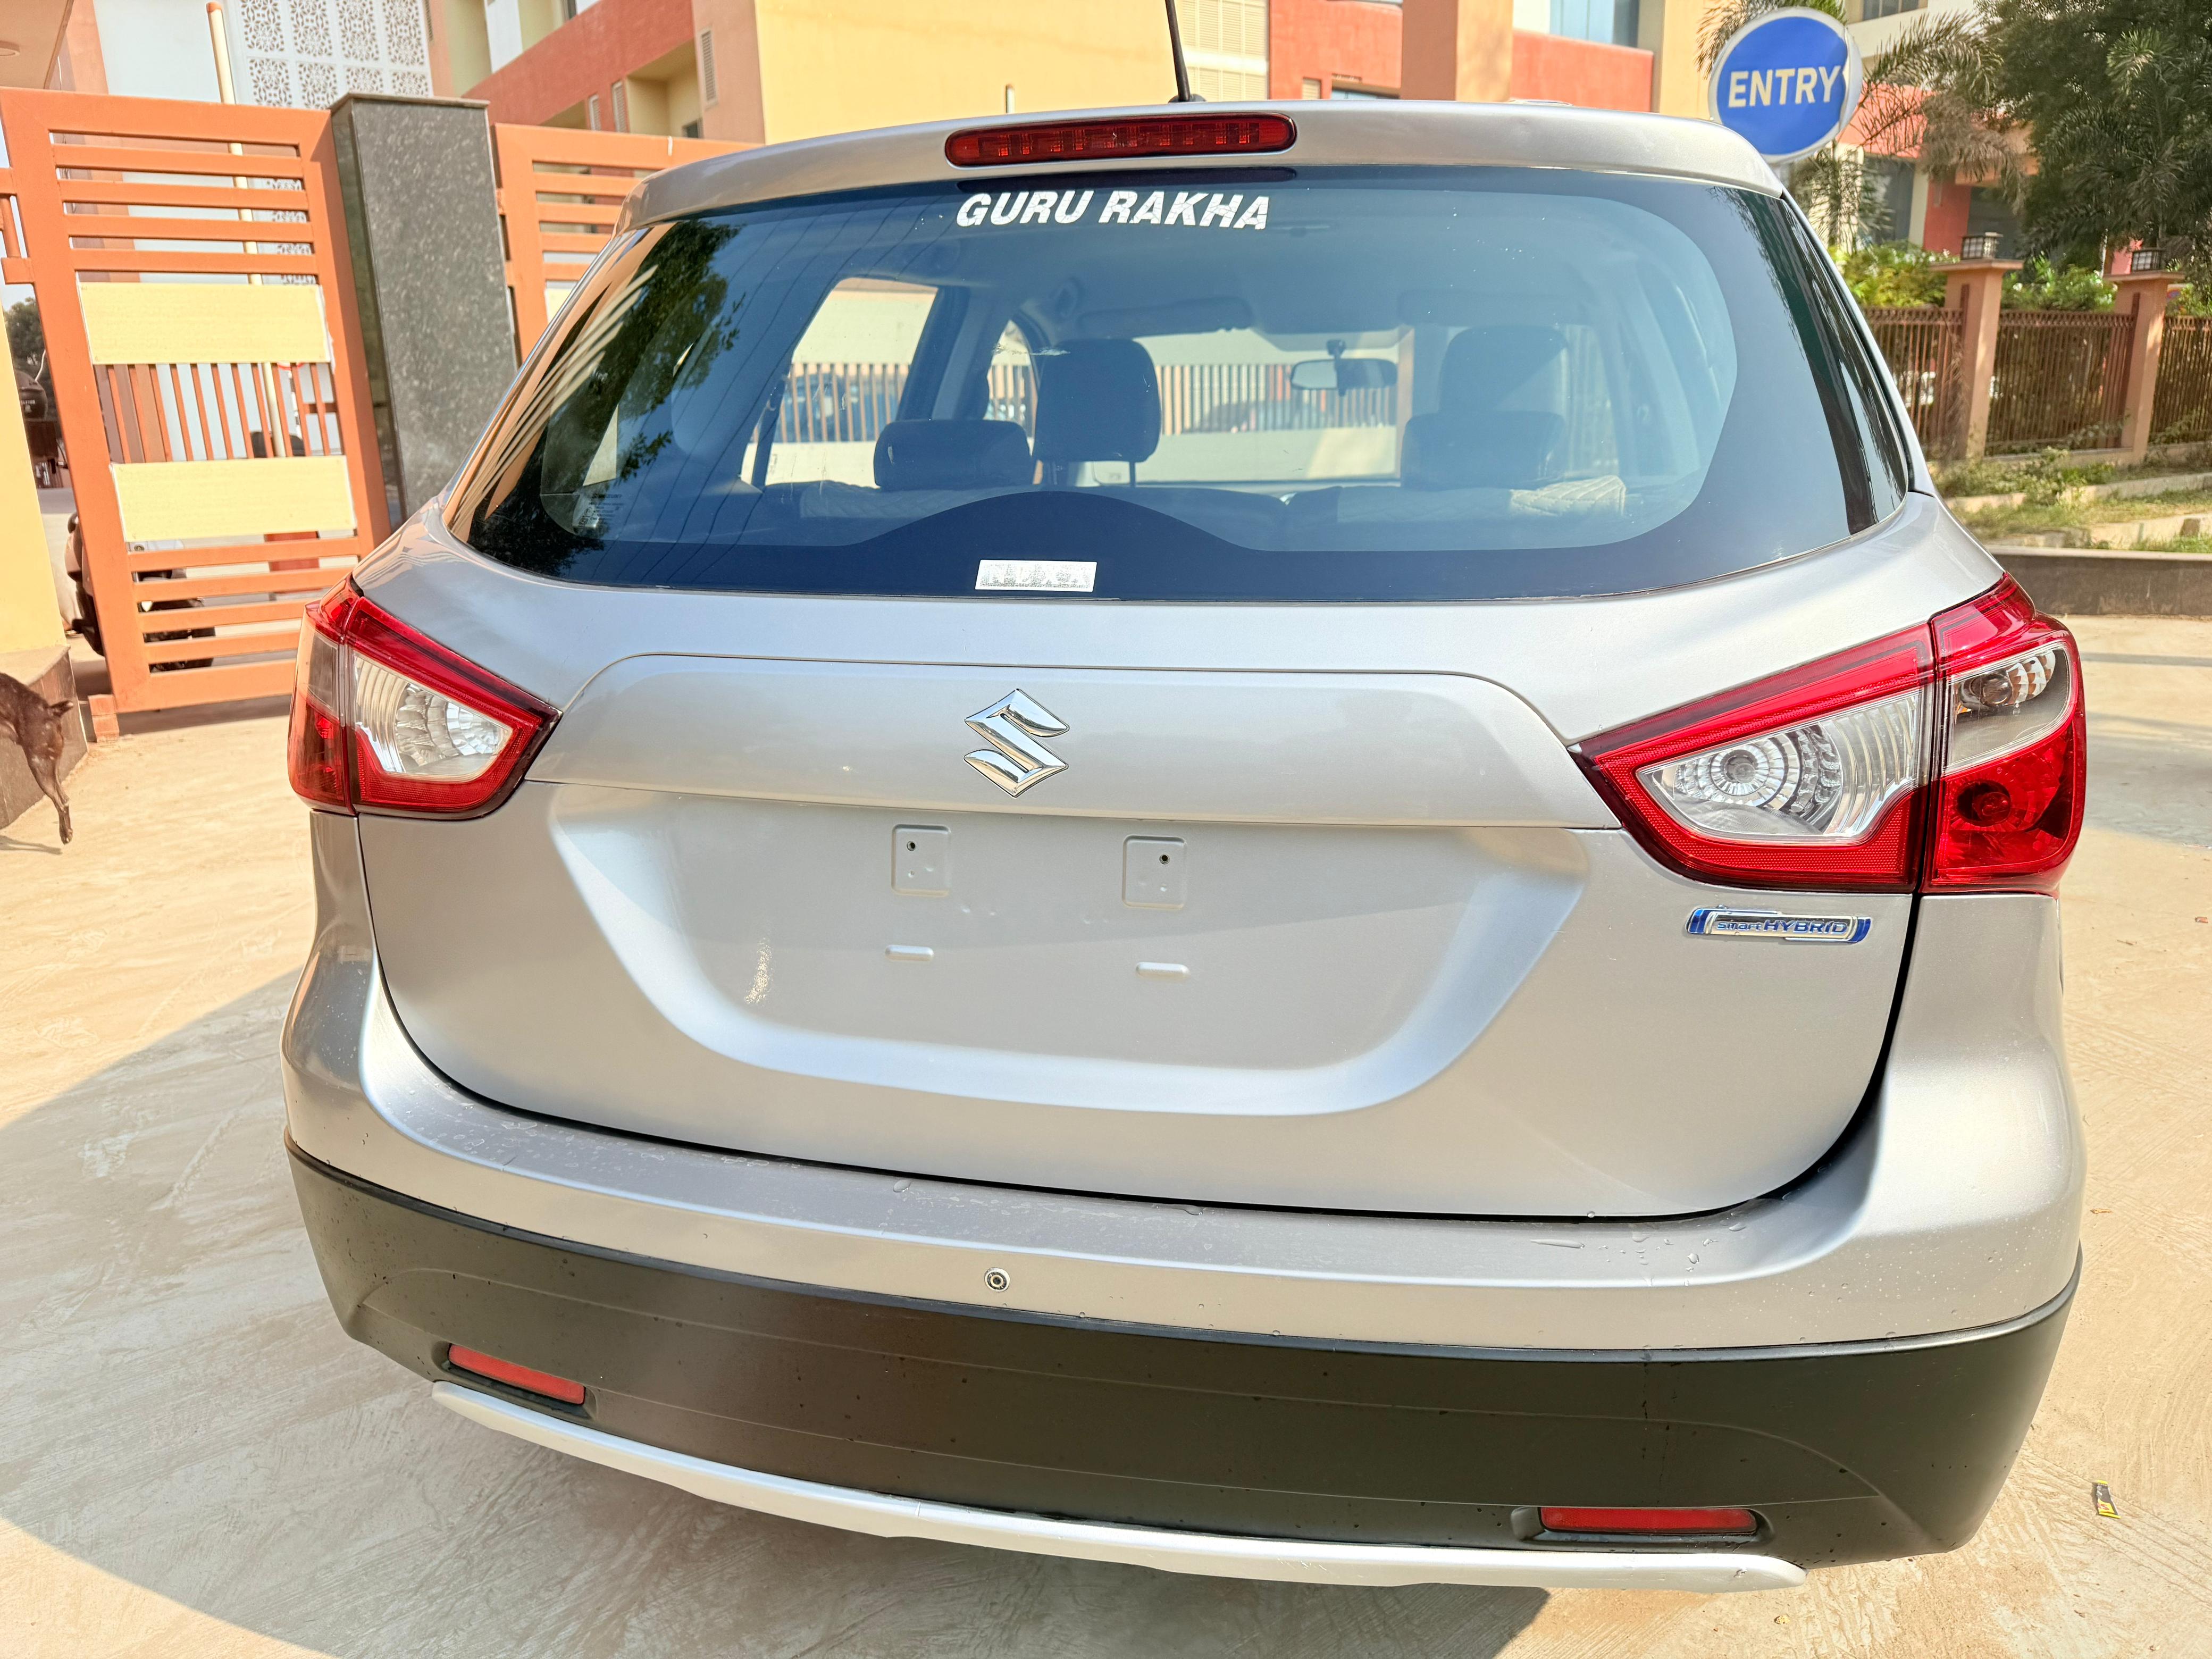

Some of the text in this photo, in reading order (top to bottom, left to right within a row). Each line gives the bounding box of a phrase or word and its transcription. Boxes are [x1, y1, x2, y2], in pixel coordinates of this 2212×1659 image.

[1729, 65, 1841, 107] ENTRY
[957, 190, 1270, 230] GURU RAKHA
[1763, 920, 1848, 935] HYBRID
